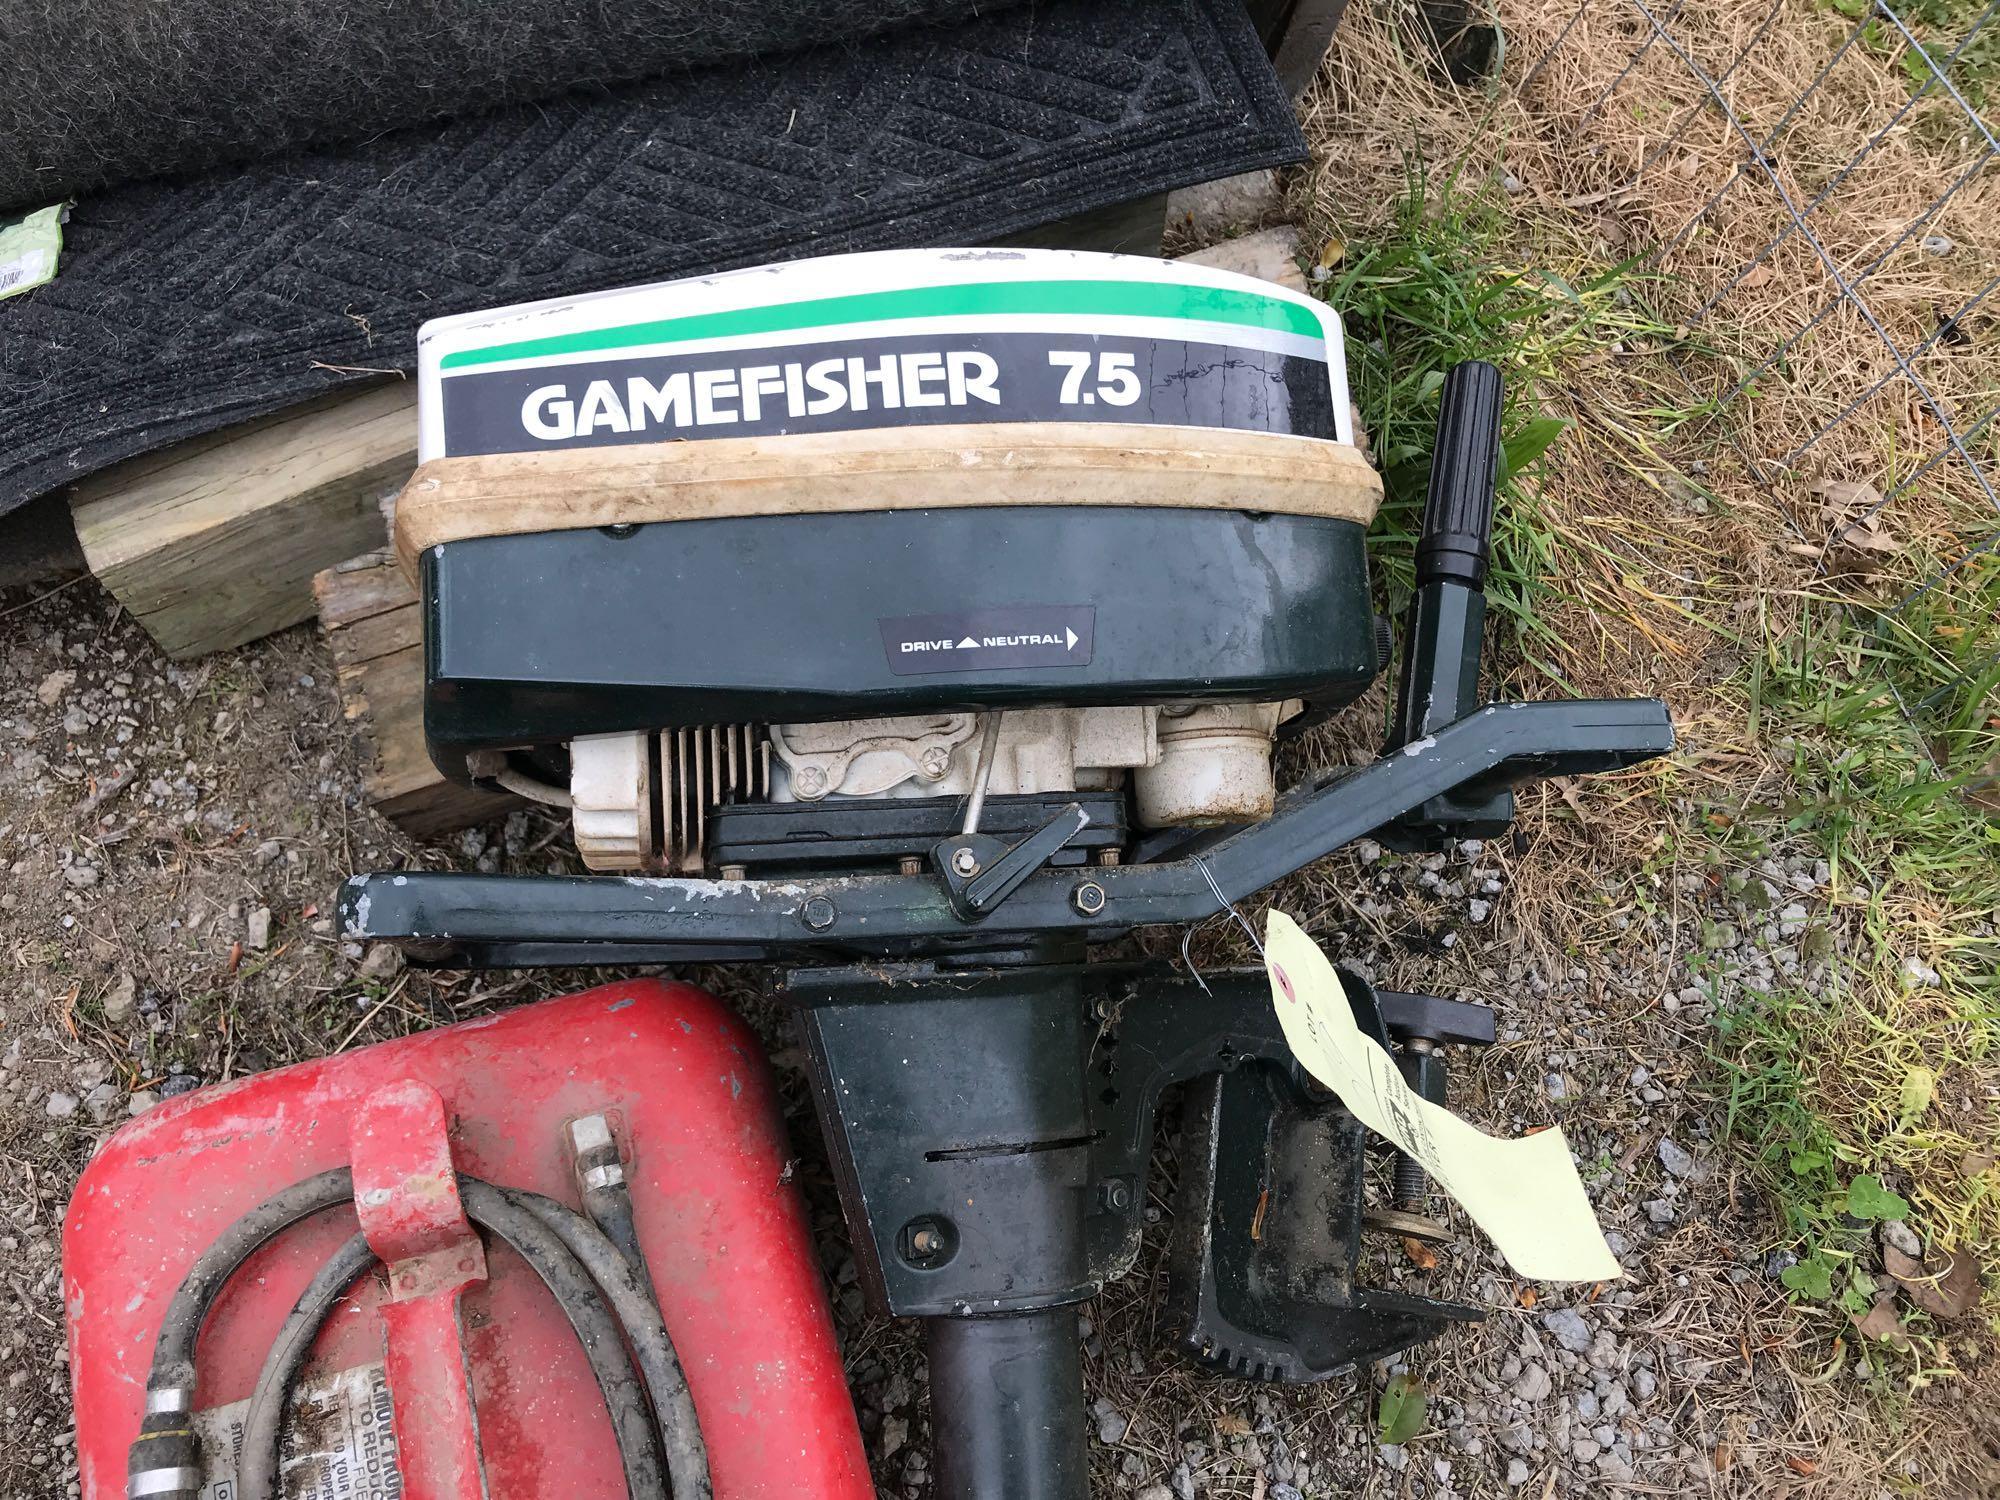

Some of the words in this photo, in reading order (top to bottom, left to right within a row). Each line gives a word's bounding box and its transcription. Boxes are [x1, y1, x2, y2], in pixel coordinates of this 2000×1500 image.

[521, 351, 1000, 441] GAMEFISHER
[1048, 351, 1142, 407] 7.5
[901, 639, 953, 652] DRIVE
[983, 634, 1063, 647] NEUTRAL
[359, 1397, 374, 1427] TO
[333, 1436, 345, 1454] TO
[334, 1457, 350, 1493] YOUR
